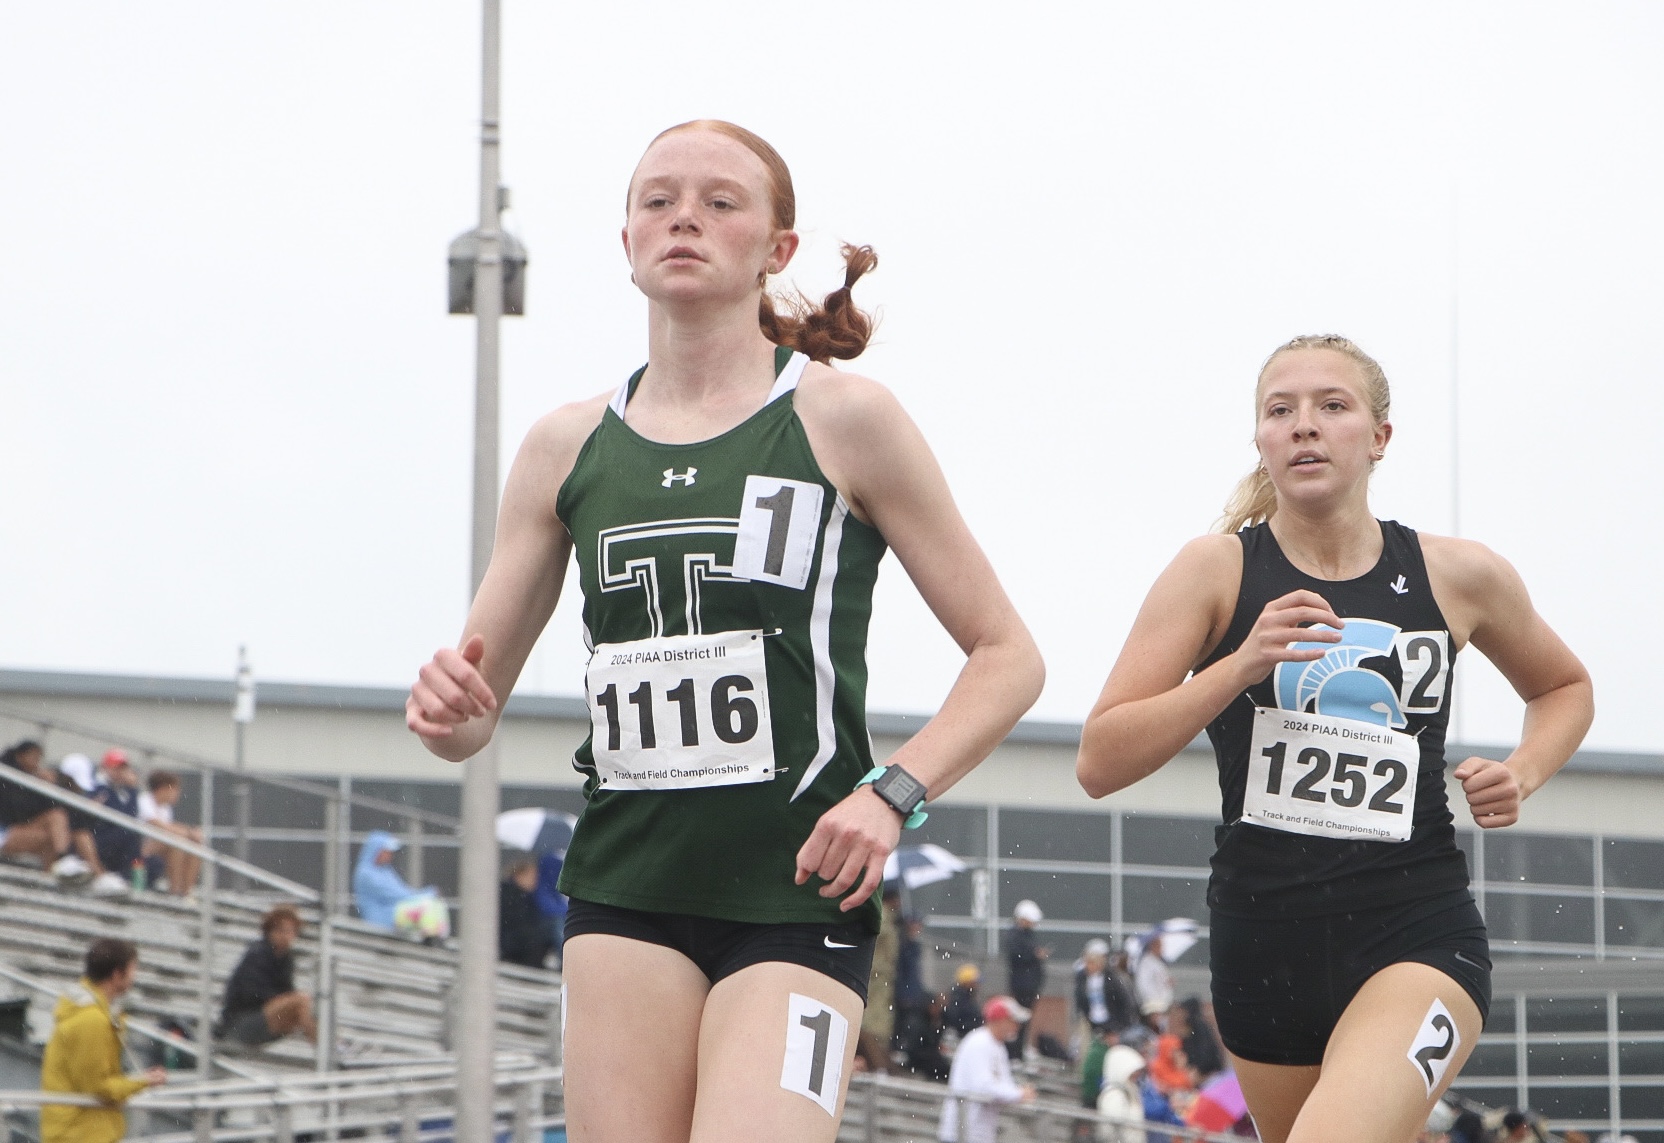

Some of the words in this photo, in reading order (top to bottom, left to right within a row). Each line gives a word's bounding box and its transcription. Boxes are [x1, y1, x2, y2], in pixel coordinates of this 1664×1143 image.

[755, 485, 795, 577] 1
[611, 653, 633, 666] 2024
[635, 651, 661, 664] PIAA
[664, 647, 712, 662] District
[714, 646, 726, 658] III
[1406, 637, 1442, 708] 2
[596, 674, 759, 751] 1116
[1283, 720, 1309, 732] 2024
[1311, 724, 1339, 737] PIAA
[1342, 729, 1381, 744] District
[1383, 735, 1393, 745] III
[614, 770, 633, 780] Track
[633, 770, 646, 780] and
[648, 769, 668, 779] Field
[670, 765, 750, 779] Championships
[1262, 742, 1408, 815] 1252
[1262, 810, 1284, 820] Track
[1286, 814, 1302, 823] and
[1303, 817, 1324, 827] Field
[1326, 820, 1391, 837] Championships
[800, 1009, 832, 1097] 1
[1415, 1014, 1454, 1088] 2
